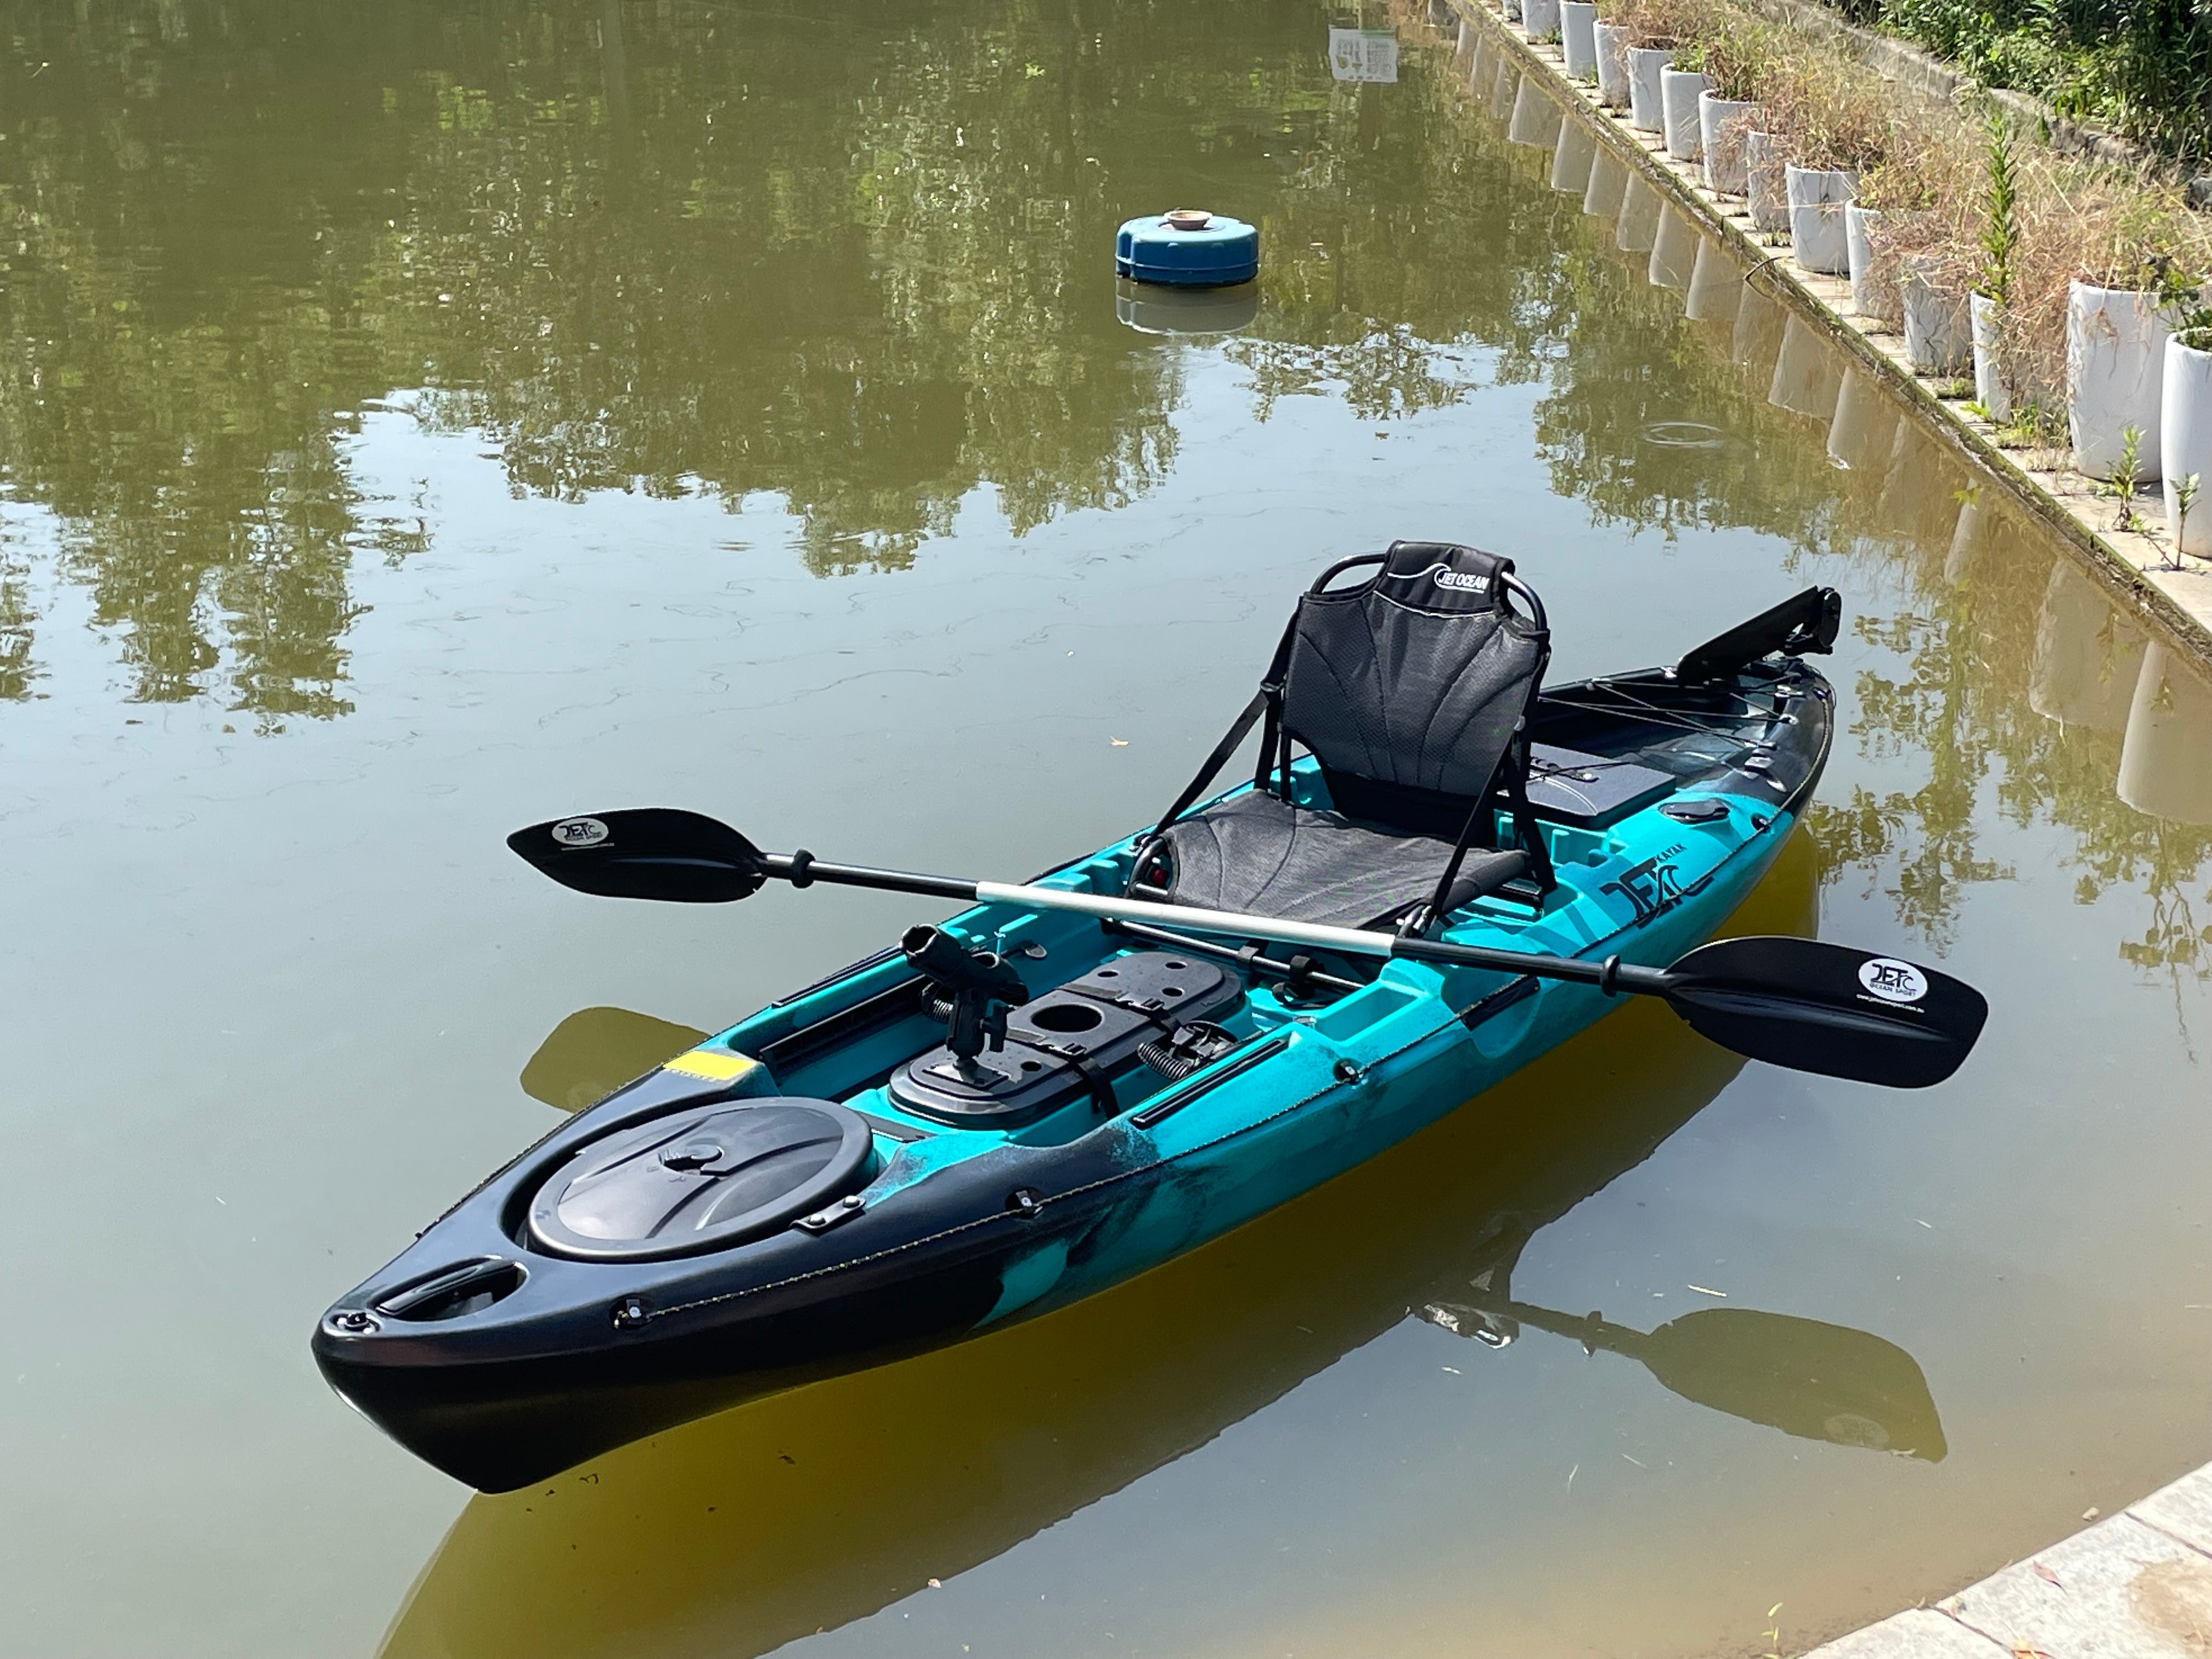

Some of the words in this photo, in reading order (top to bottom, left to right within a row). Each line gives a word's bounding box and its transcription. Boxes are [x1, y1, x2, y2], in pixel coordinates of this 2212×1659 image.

[1438, 572, 1458, 585] JET
[1455, 573, 1490, 590] OCEAN
[1654, 842, 1688, 863] KAYAK
